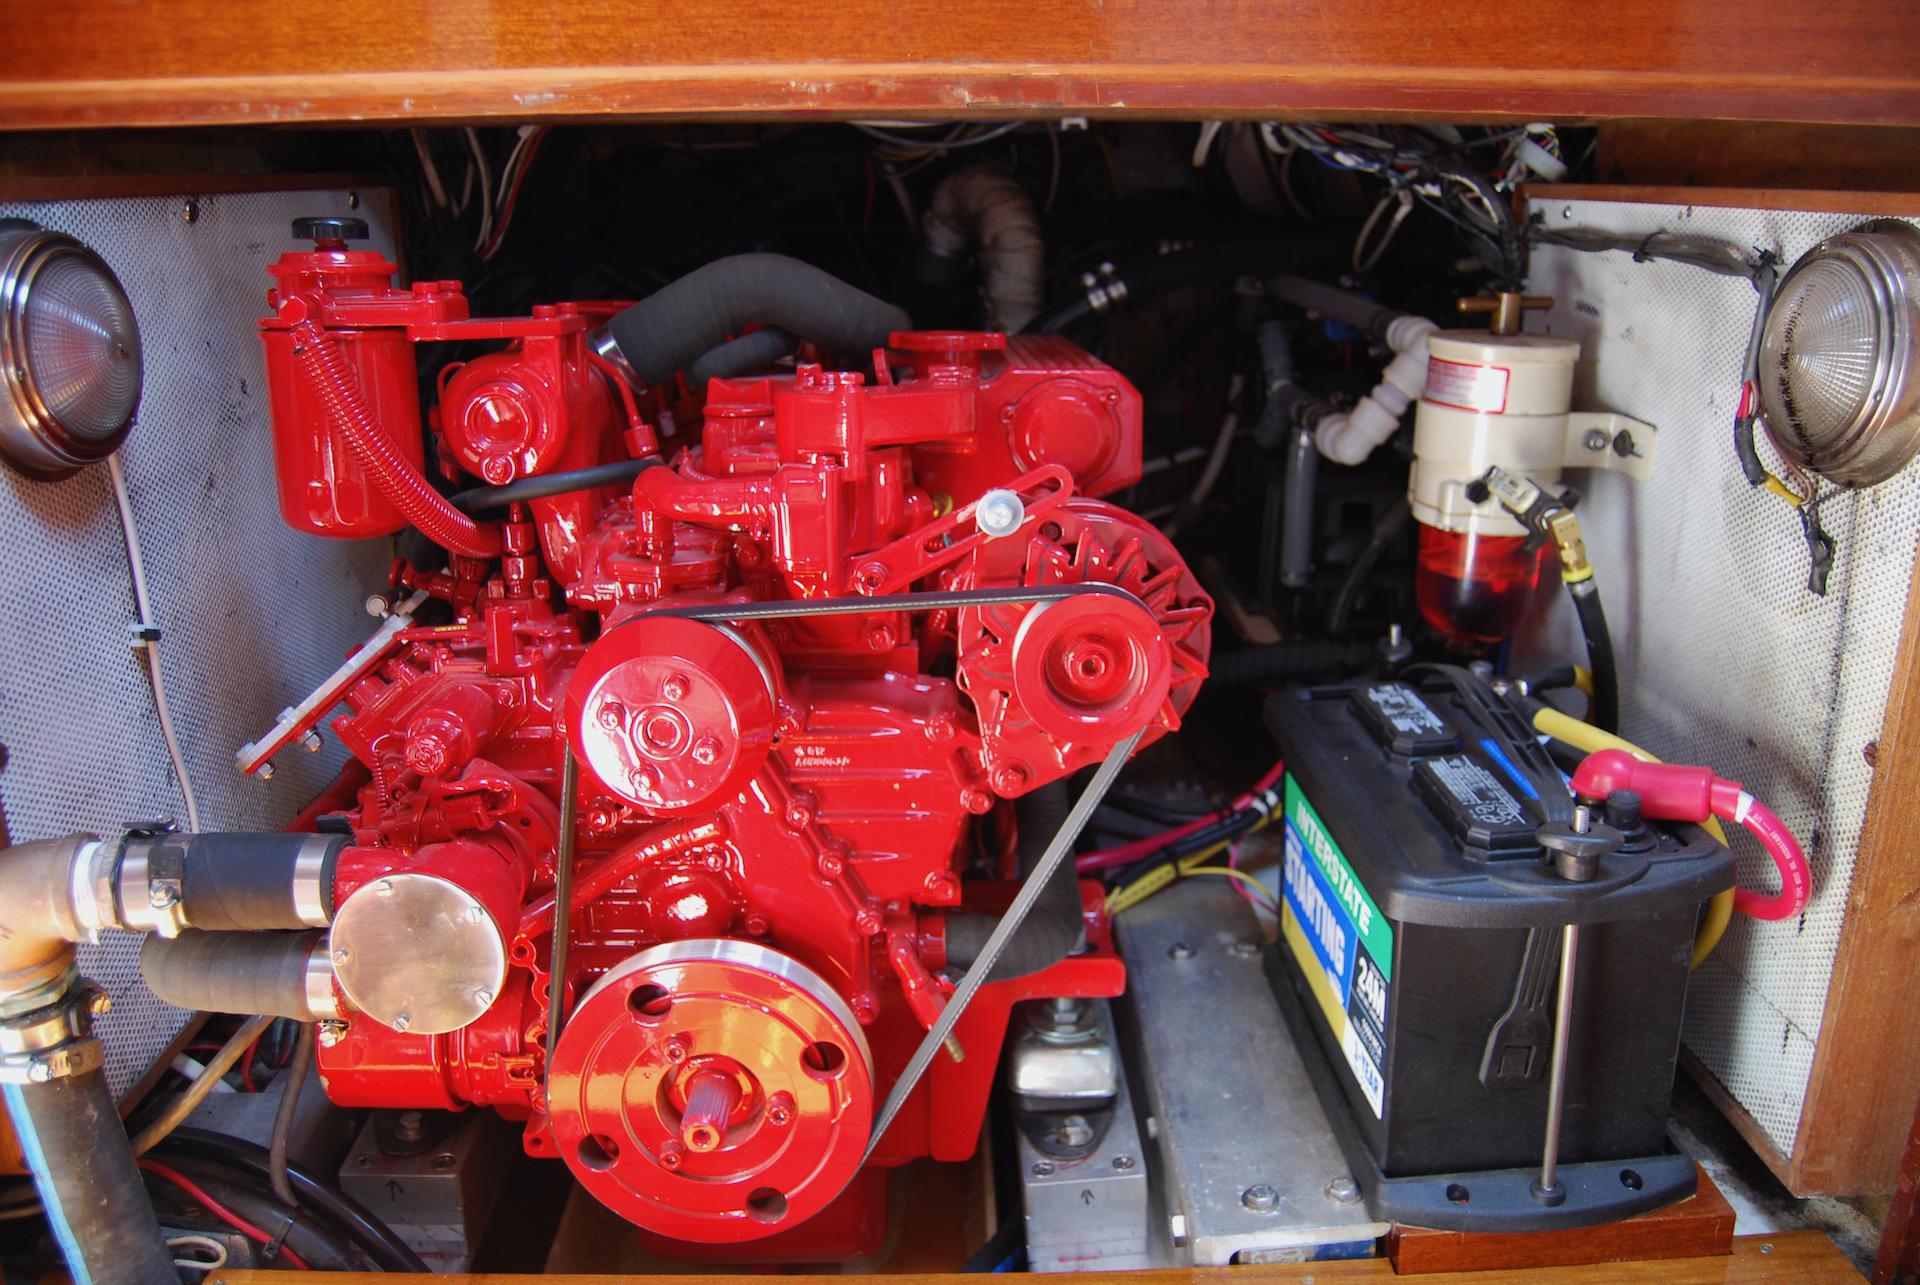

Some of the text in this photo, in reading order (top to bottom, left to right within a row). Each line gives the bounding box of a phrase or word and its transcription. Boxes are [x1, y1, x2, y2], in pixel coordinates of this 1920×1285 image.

[1285, 838, 1345, 977] STARTING
[1296, 801, 1371, 935] INTERSTATE
[1357, 956, 1386, 1023] 24M
